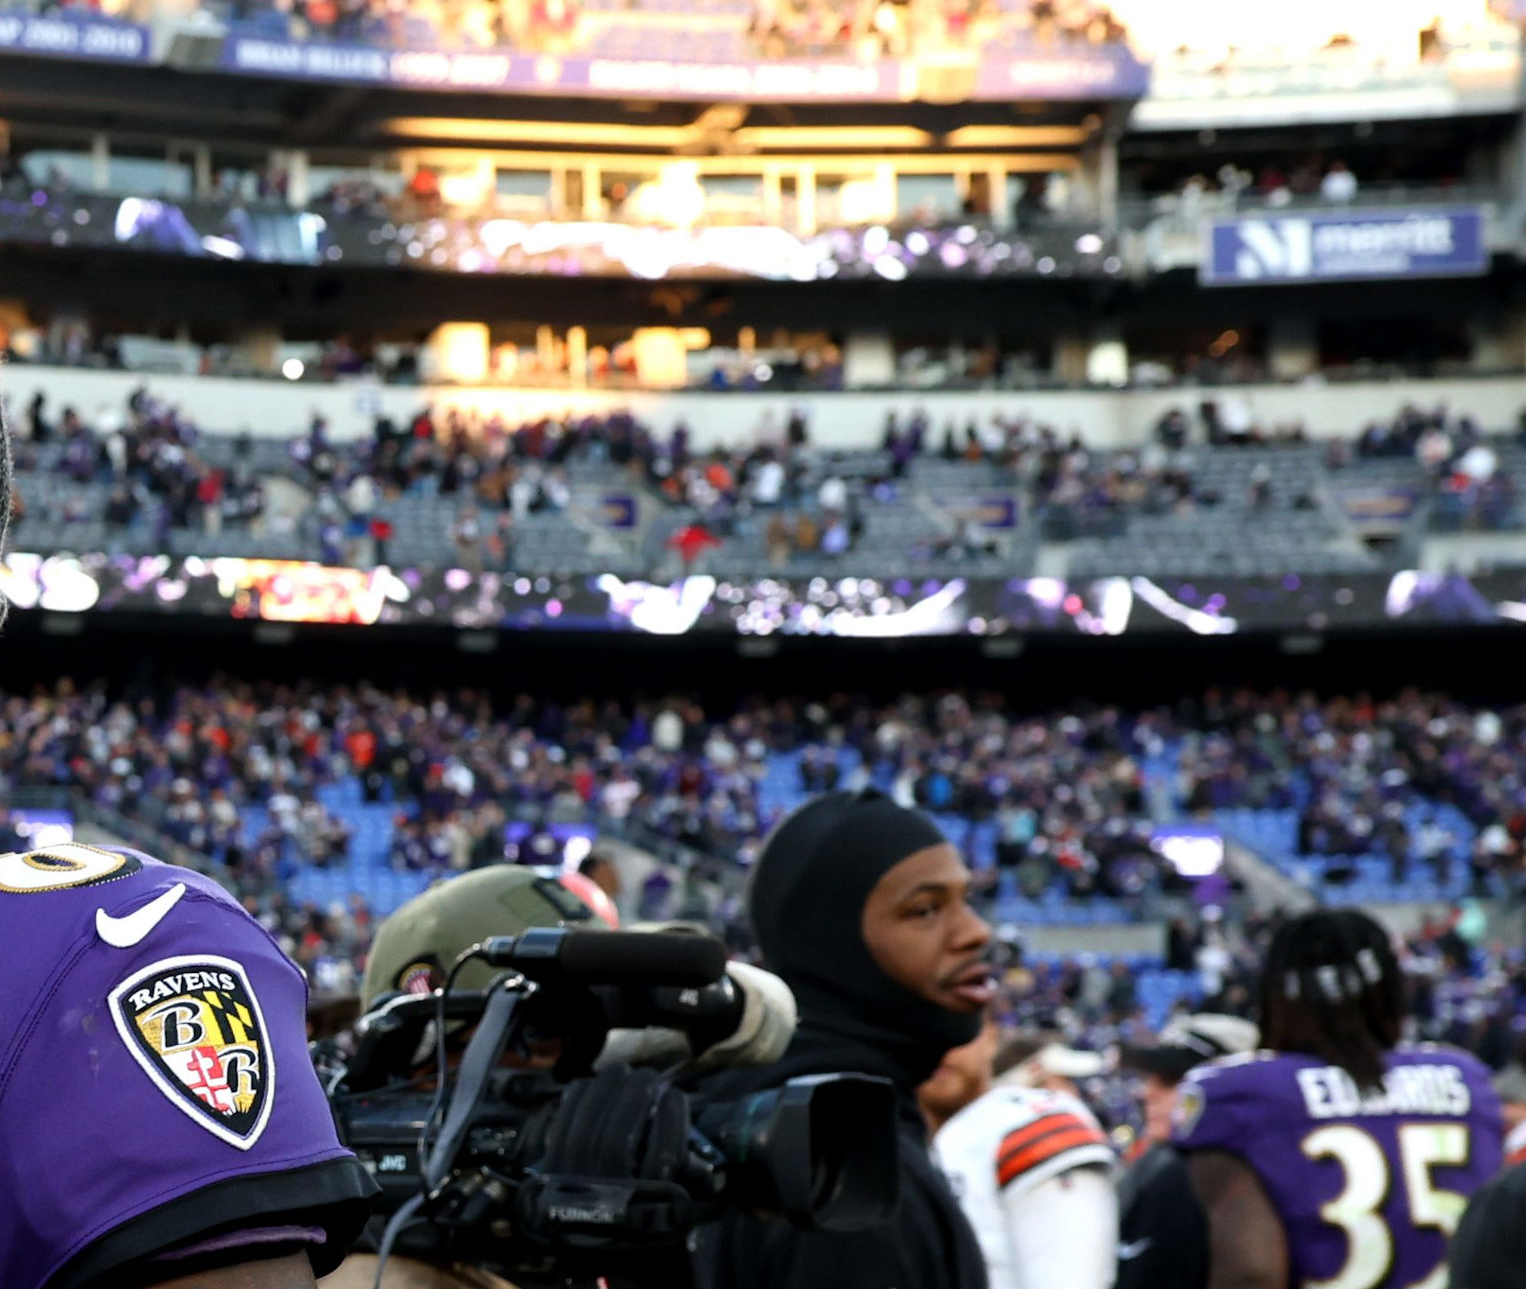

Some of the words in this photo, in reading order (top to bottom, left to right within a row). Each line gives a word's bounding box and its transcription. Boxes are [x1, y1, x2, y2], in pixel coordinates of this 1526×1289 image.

[128, 971, 236, 1012] RAVENS
[1295, 1064, 1471, 1119] EDARDS
[378, 1154, 406, 1172] JVC
